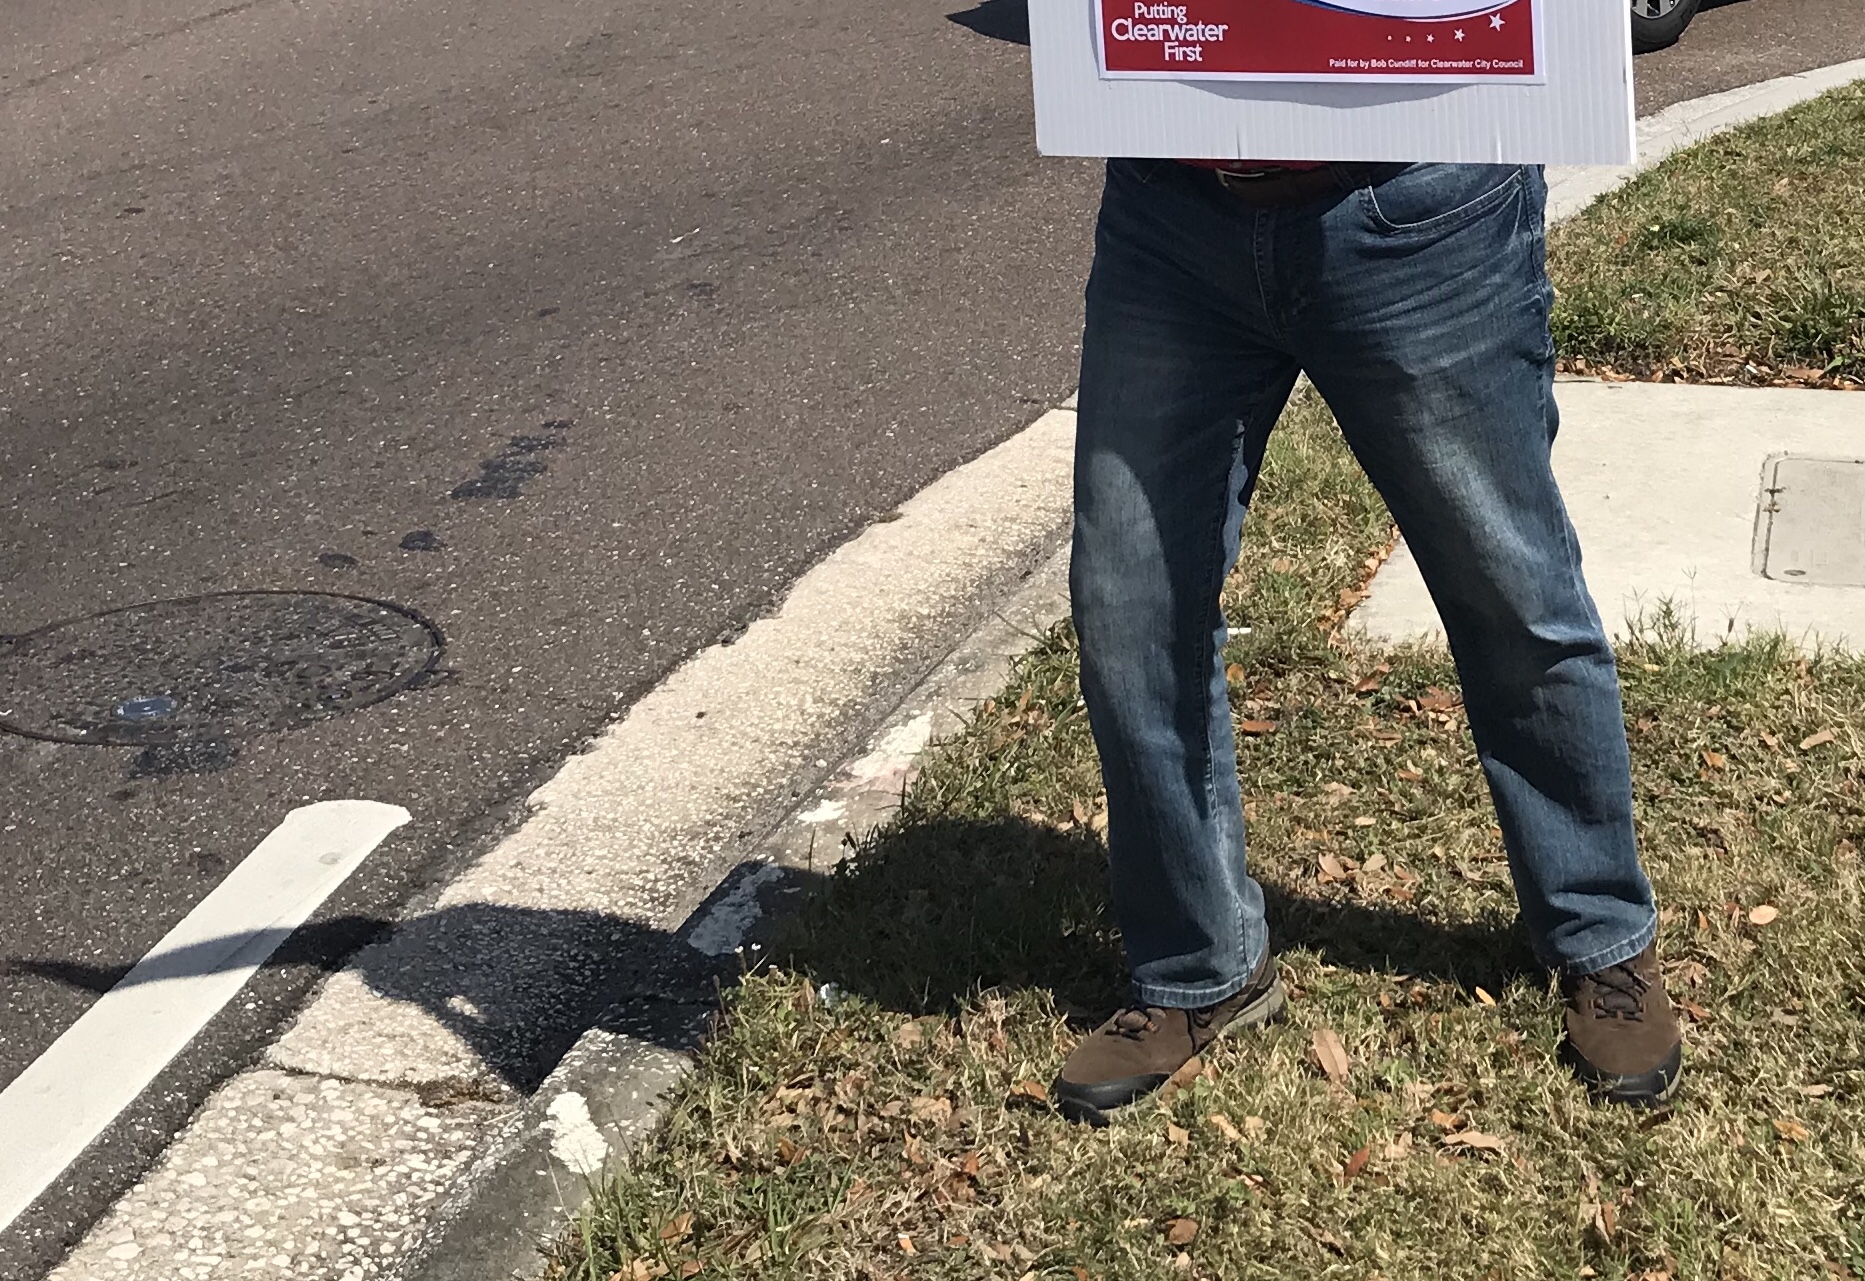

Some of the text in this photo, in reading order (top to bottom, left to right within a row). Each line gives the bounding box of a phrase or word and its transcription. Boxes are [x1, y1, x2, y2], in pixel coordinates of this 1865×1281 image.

[1134, 1, 1188, 24] Putting
[1111, 17, 1229, 42] Clearwater
[1164, 41, 1203, 62] First
[1329, 58, 1523, 70] Paid for by Bob Cundiff for Clearwater City Council
